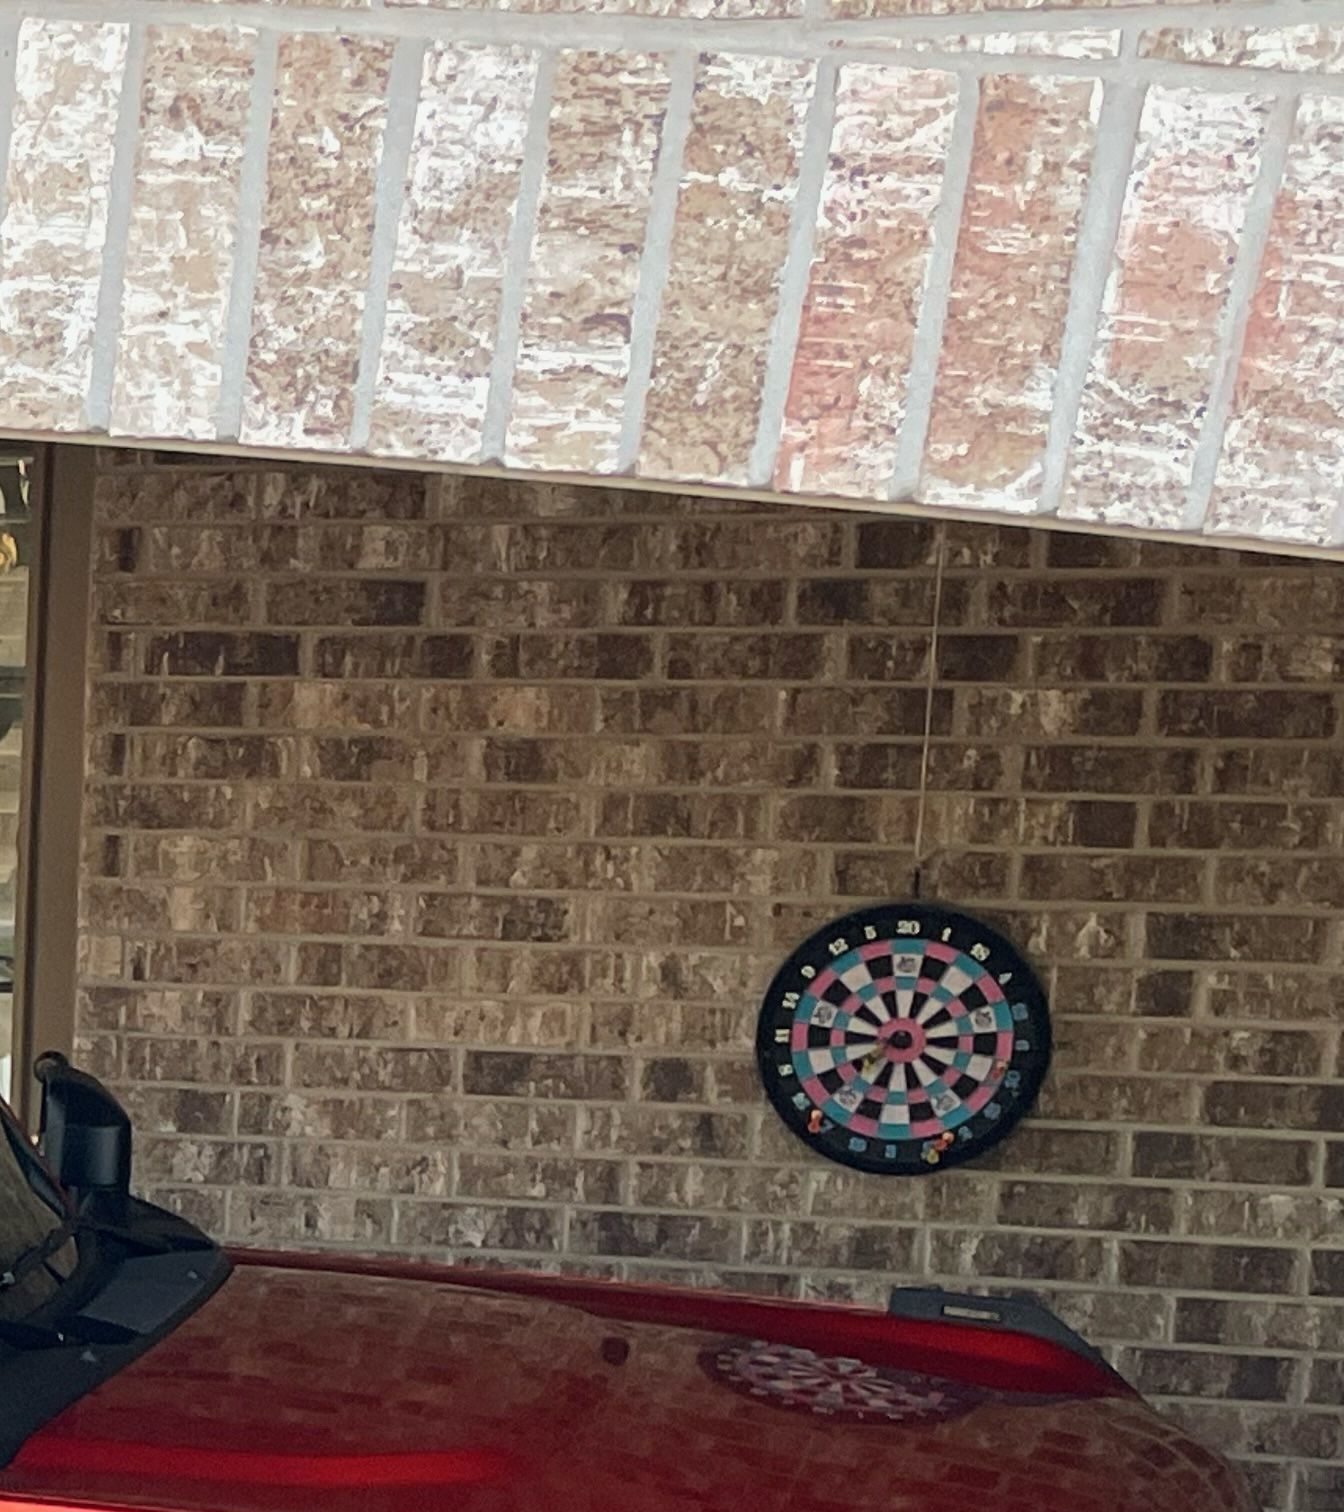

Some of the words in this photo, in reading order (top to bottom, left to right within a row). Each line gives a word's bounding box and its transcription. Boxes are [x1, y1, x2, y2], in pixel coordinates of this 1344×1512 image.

[863, 924, 877, 940] 5
[896, 919, 921, 935] 20
[941, 926, 952, 942] 1
